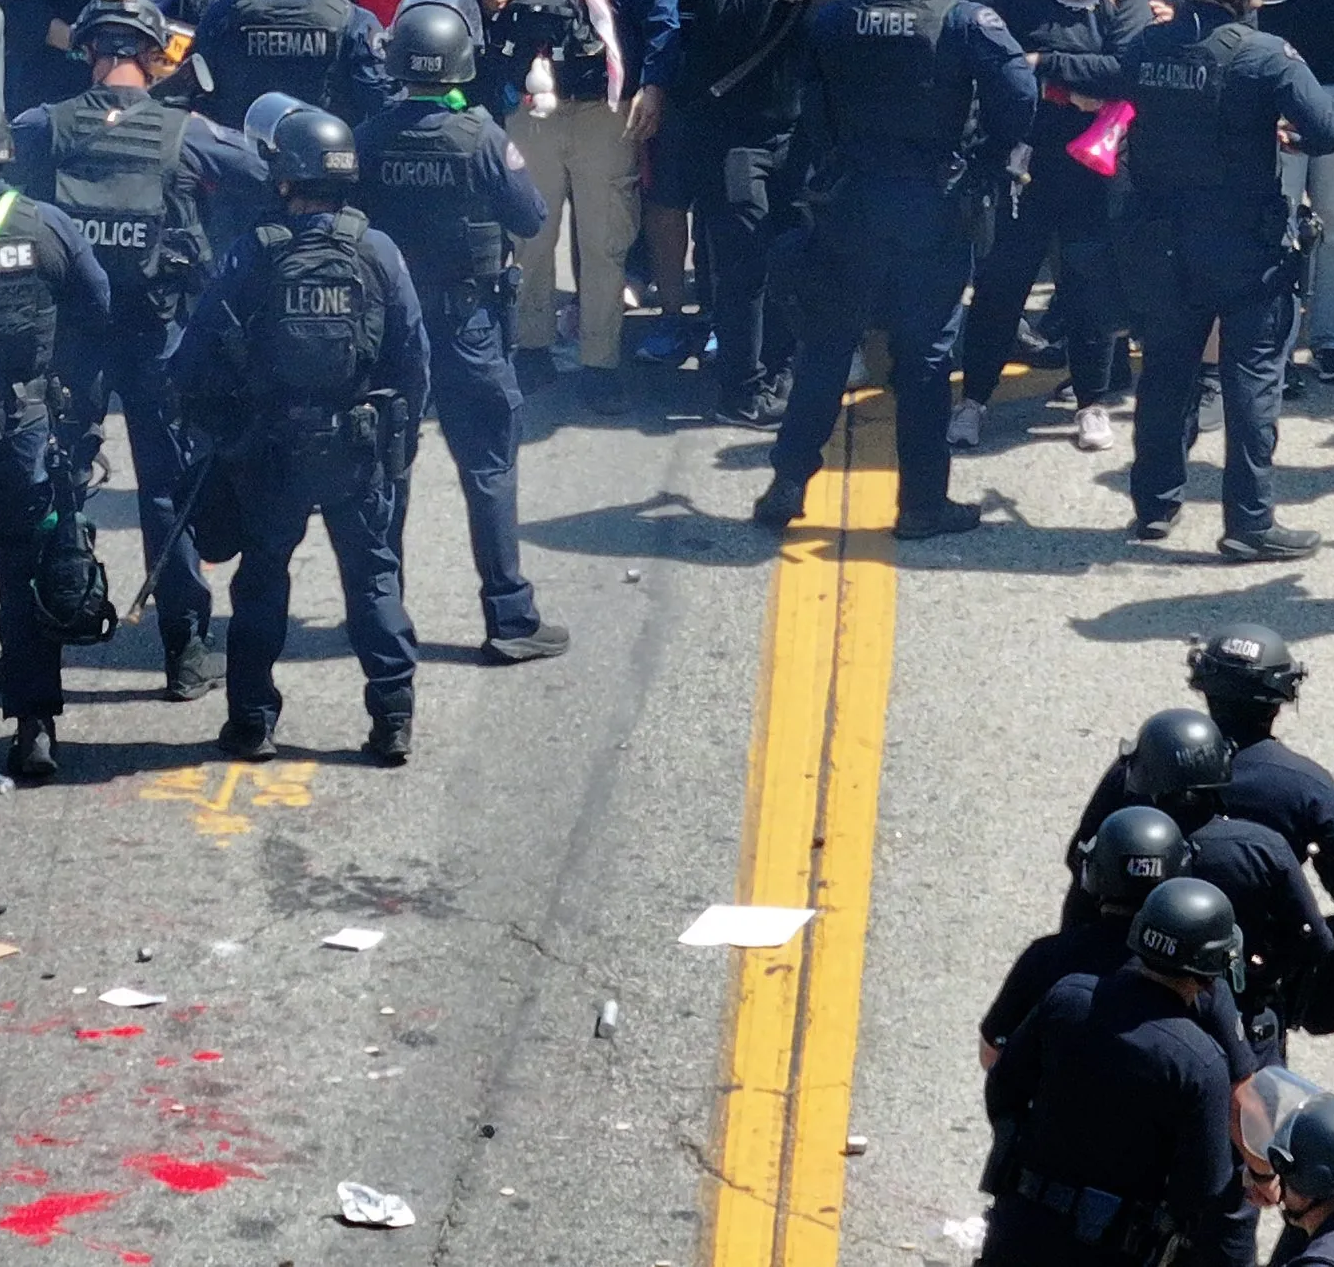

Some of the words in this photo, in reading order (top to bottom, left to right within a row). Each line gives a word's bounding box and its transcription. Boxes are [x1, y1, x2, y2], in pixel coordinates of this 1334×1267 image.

[856, 11, 917, 37] URIBE
[247, 30, 327, 57] FREEMAN
[381, 160, 456, 187] CORONA
[71, 219, 148, 248] POLICE
[285, 285, 352, 315] LEONE
